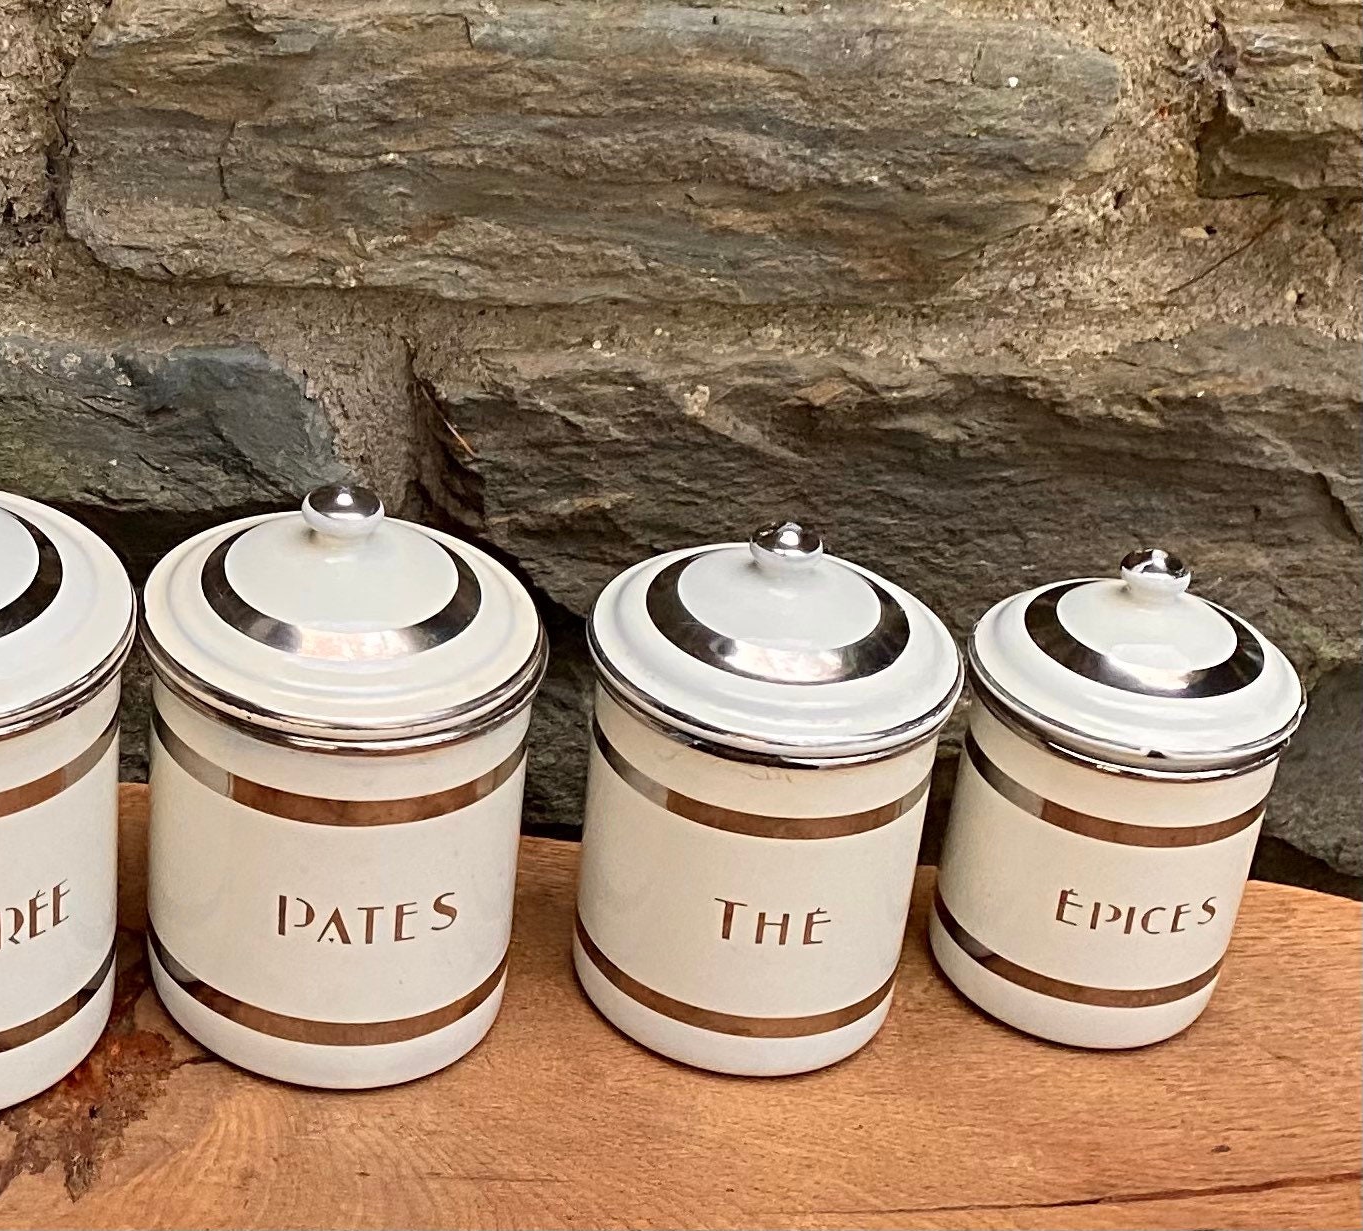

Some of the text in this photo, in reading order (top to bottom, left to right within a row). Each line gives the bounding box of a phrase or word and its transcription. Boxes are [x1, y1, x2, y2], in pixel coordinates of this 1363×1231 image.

[277, 892, 458, 945] PATES
[714, 897, 832, 946] THÉ
[1055, 888, 1218, 935] ÉPICES
